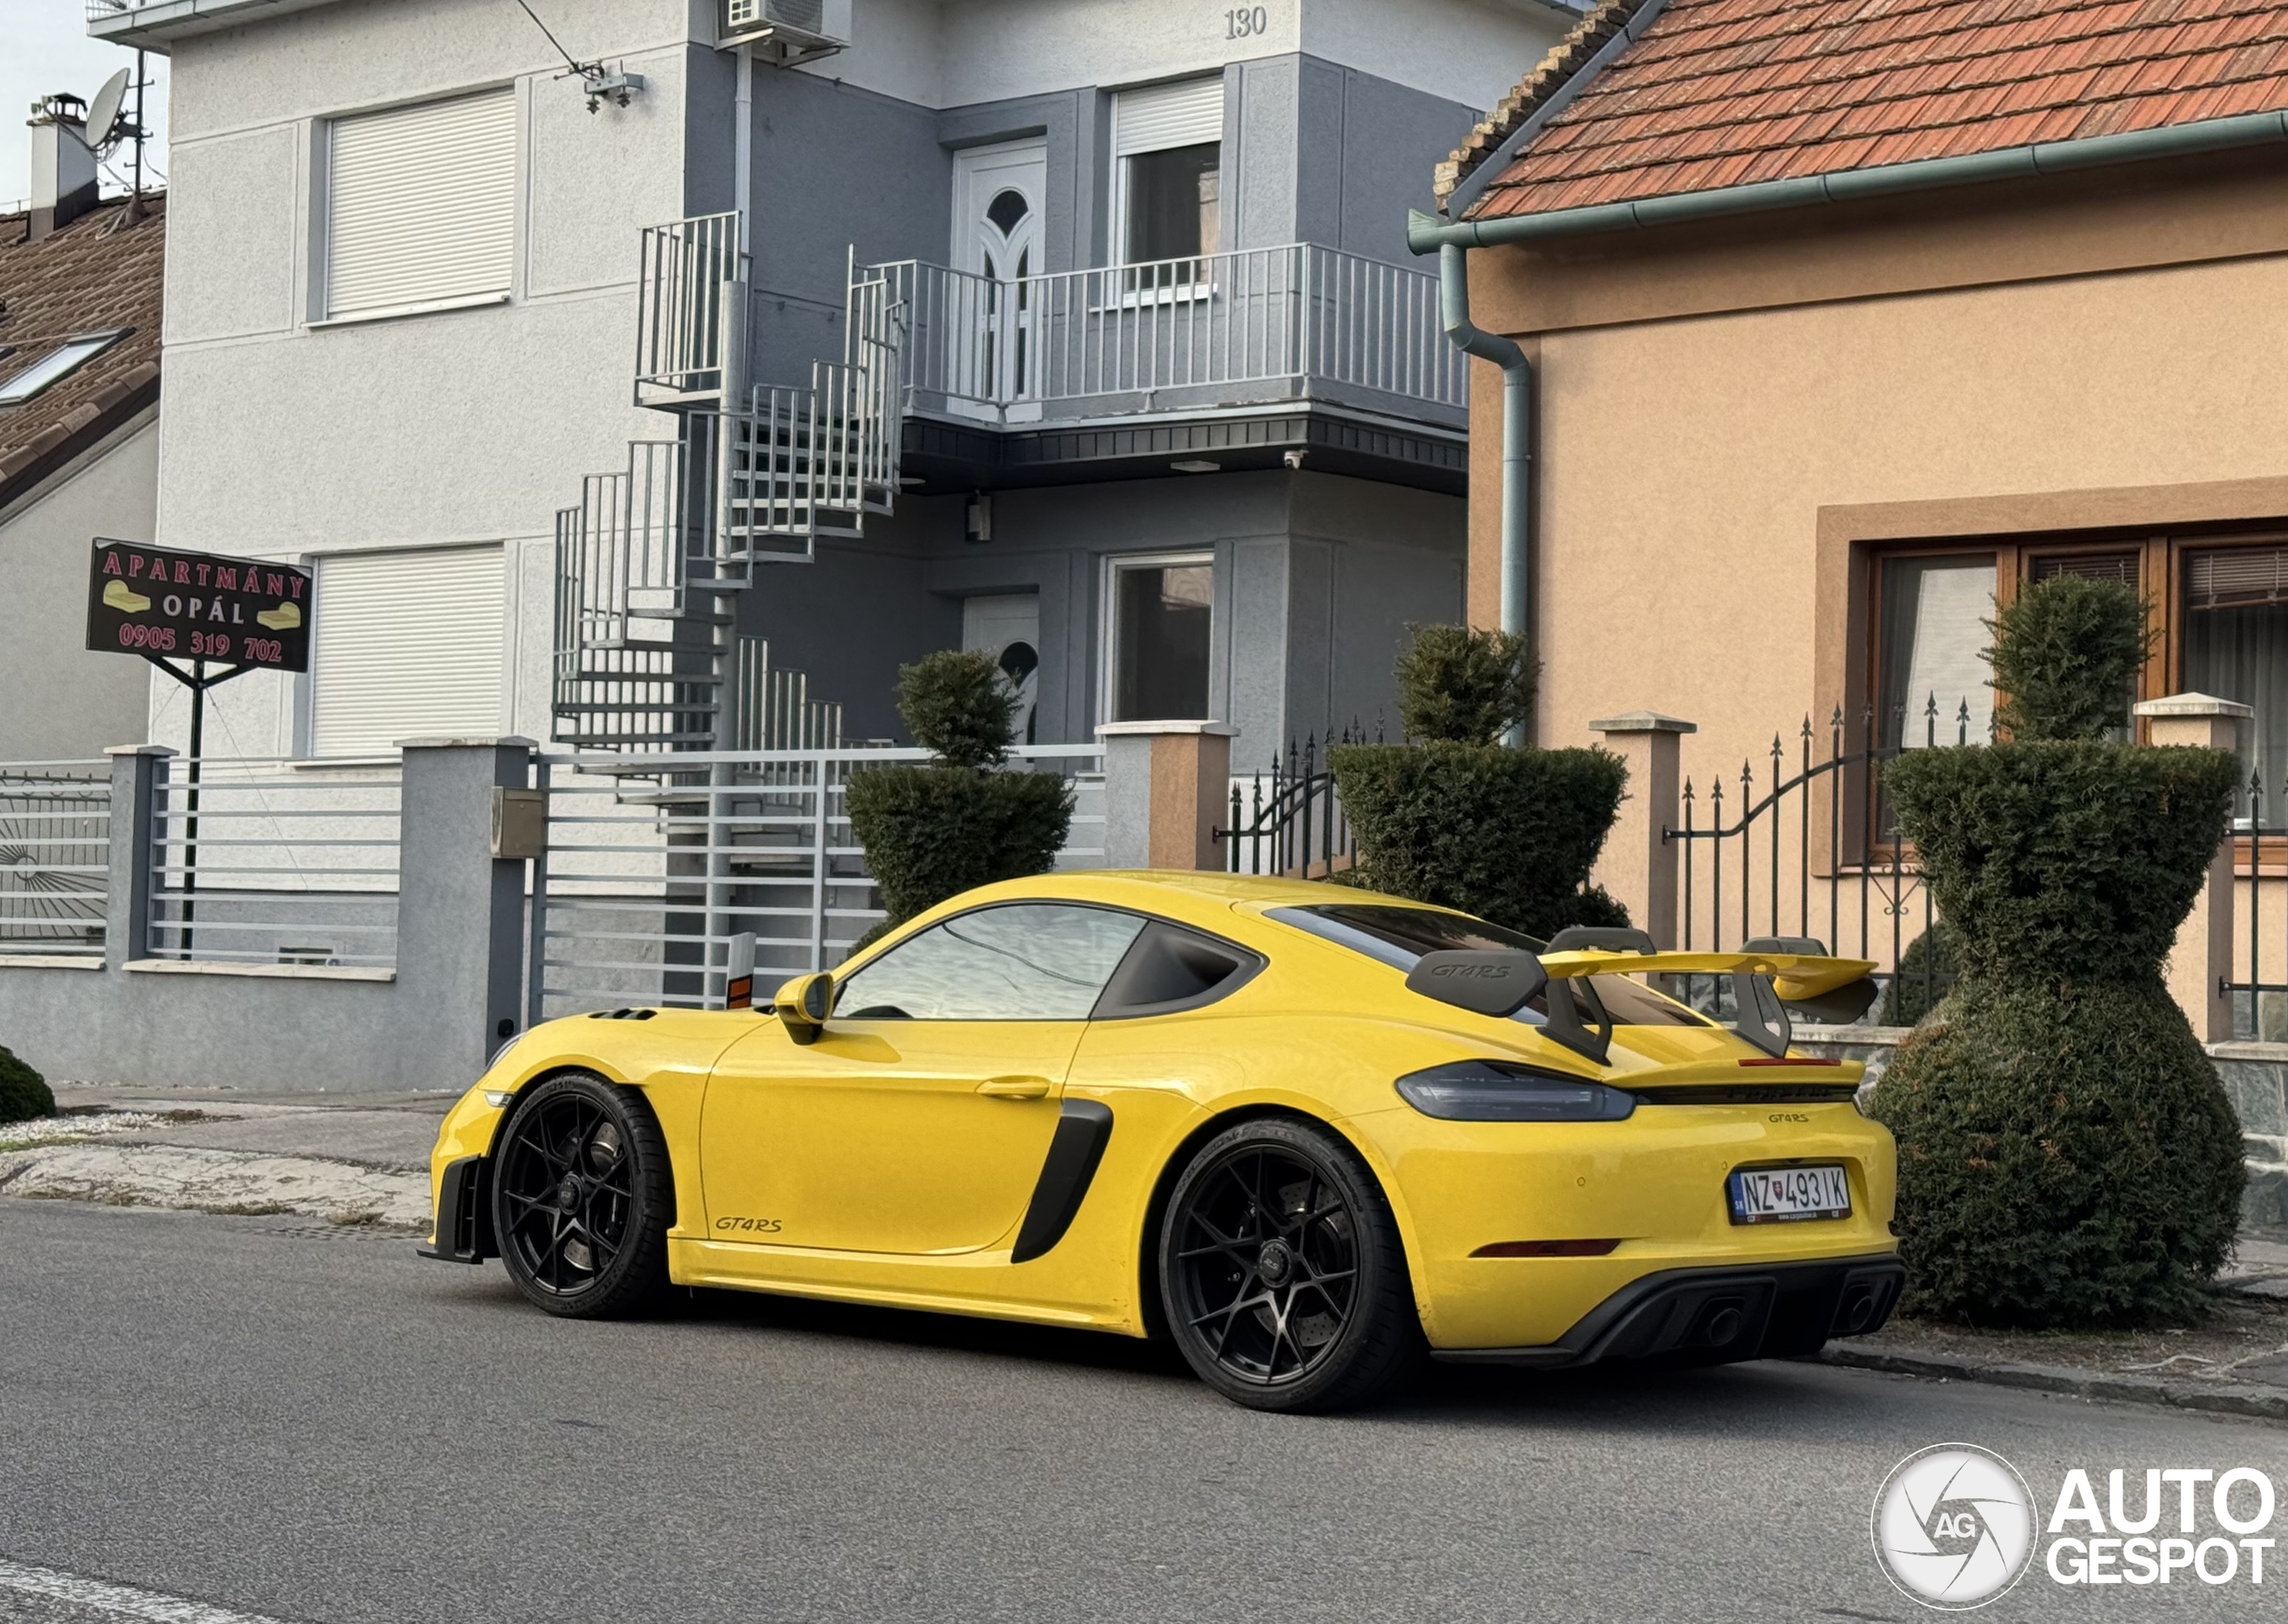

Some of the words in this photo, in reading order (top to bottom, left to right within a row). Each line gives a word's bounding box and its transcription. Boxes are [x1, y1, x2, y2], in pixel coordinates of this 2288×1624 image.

[1224, 5, 1267, 40] 130
[103, 551, 304, 599] APARTMÁNY
[163, 594, 245, 624] OPÁL
[119, 623, 176, 651] 0905
[190, 631, 231, 657] 319
[244, 637, 282, 662] 702
[1744, 1174, 1775, 1212] NZ
[1786, 1170, 1846, 1209] 493IK
